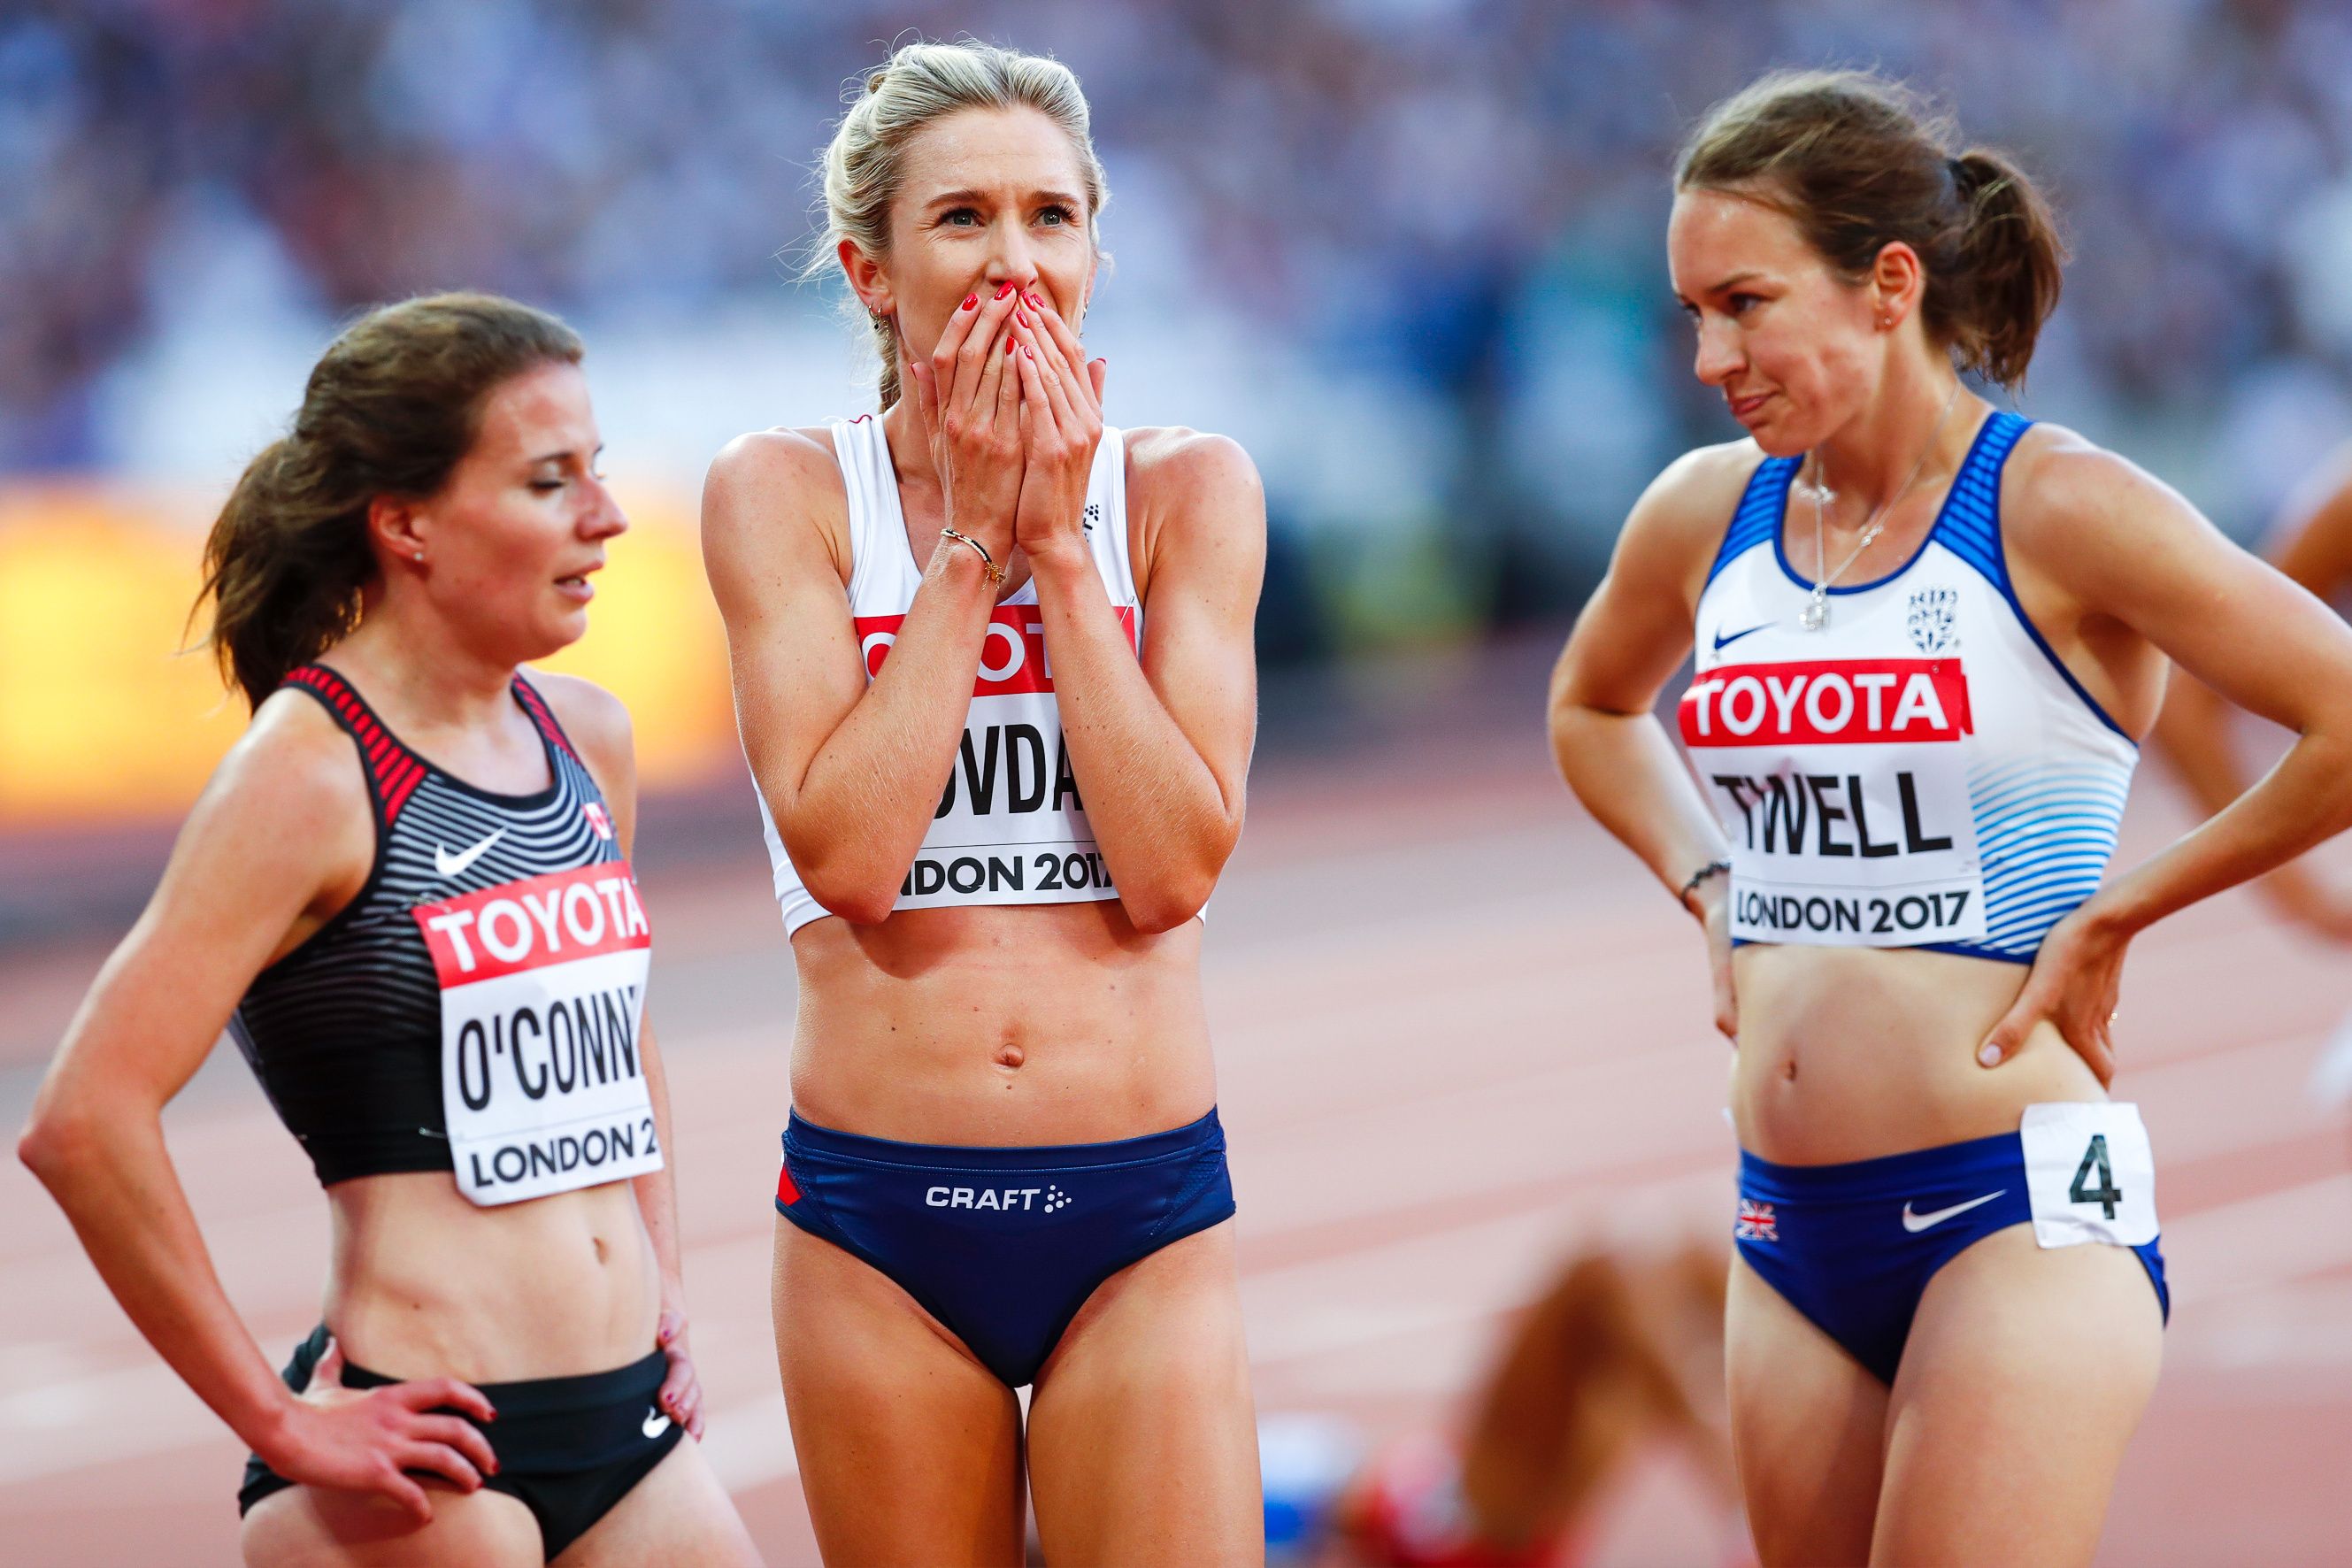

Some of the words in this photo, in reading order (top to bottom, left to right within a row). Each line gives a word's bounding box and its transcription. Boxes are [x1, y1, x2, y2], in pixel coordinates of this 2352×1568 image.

[1695, 673, 1949, 736] TOYOTA
[1711, 772, 1953, 858] TWELL
[429, 877, 649, 972] TOYOTA
[1737, 892, 1861, 933] LONDON
[1869, 890, 1972, 934] 2017
[457, 985, 636, 1112] O'CONN
[471, 1122, 635, 1188] LONDON
[641, 1118, 658, 1156] 2
[2069, 1134, 2122, 1220] 4
[926, 1186, 1041, 1211] CRAFT
